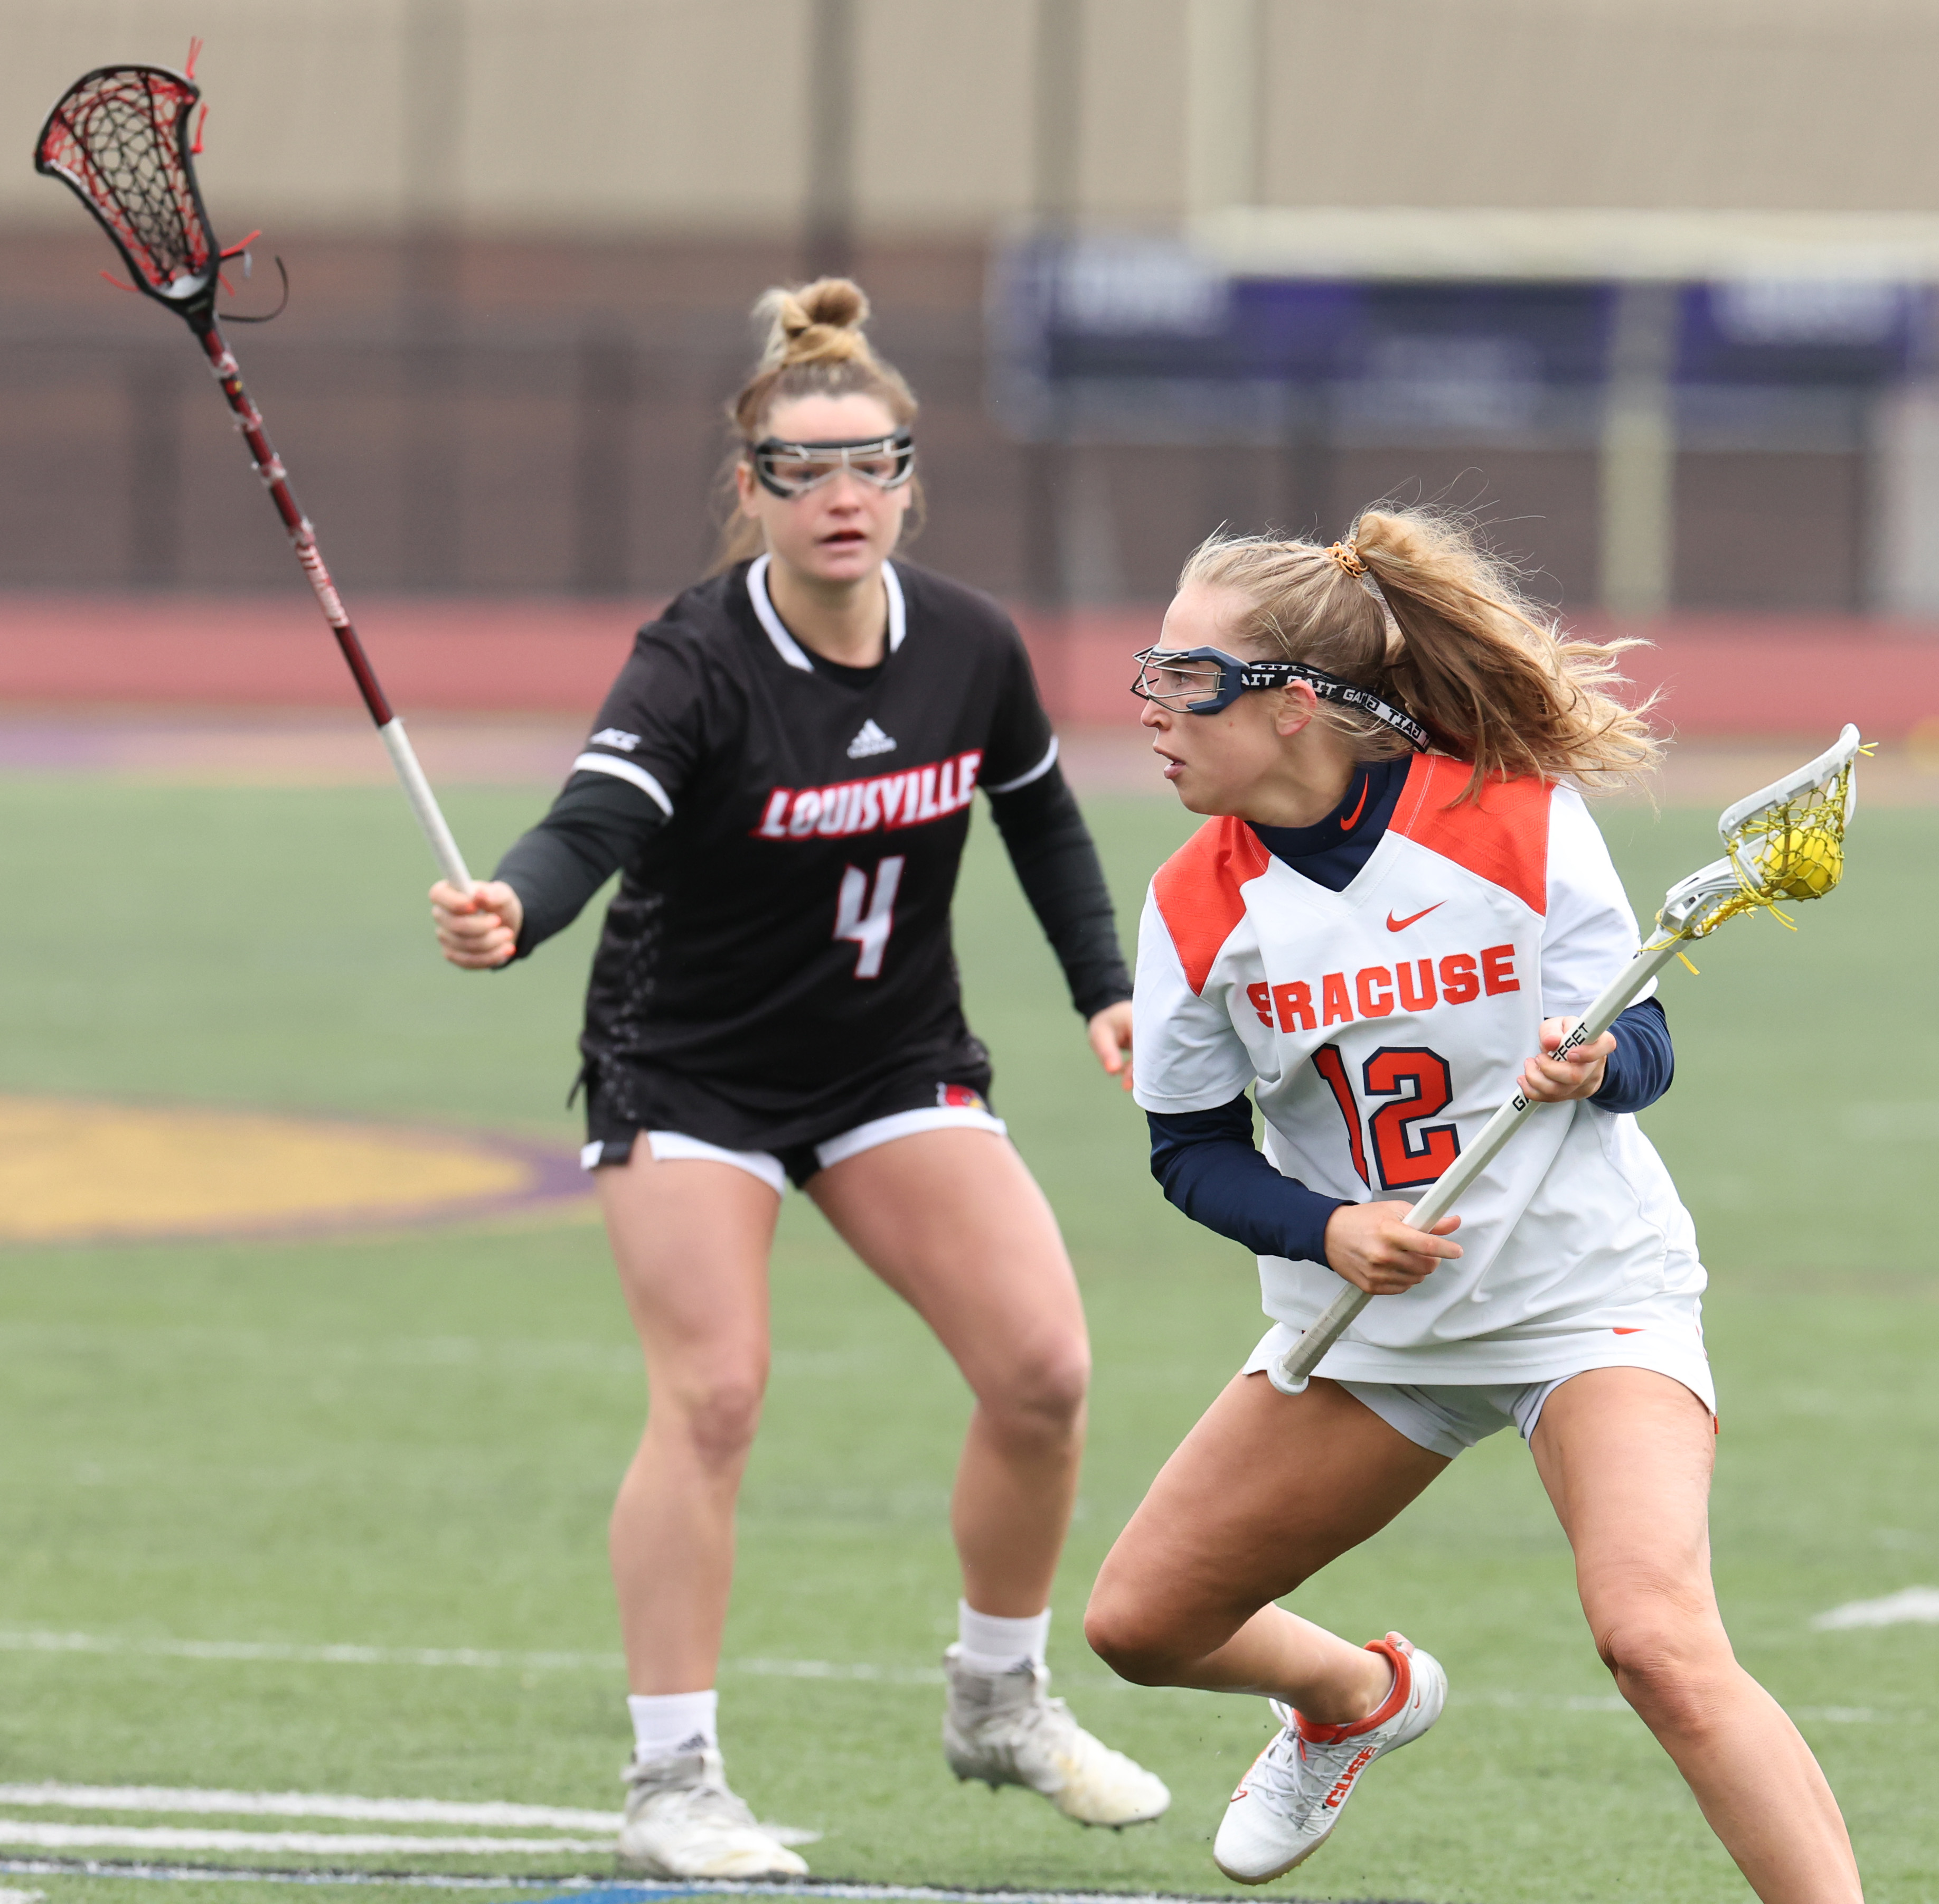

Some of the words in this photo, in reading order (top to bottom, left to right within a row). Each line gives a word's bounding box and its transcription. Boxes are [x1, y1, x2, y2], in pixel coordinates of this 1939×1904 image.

[749, 748, 985, 840] LOUISVILLE
[833, 855, 905, 979] 4
[1246, 943, 1520, 1034] SRACUSE
[1310, 1042, 1462, 1192] 12
[1325, 1744, 1378, 1808] CUSE
